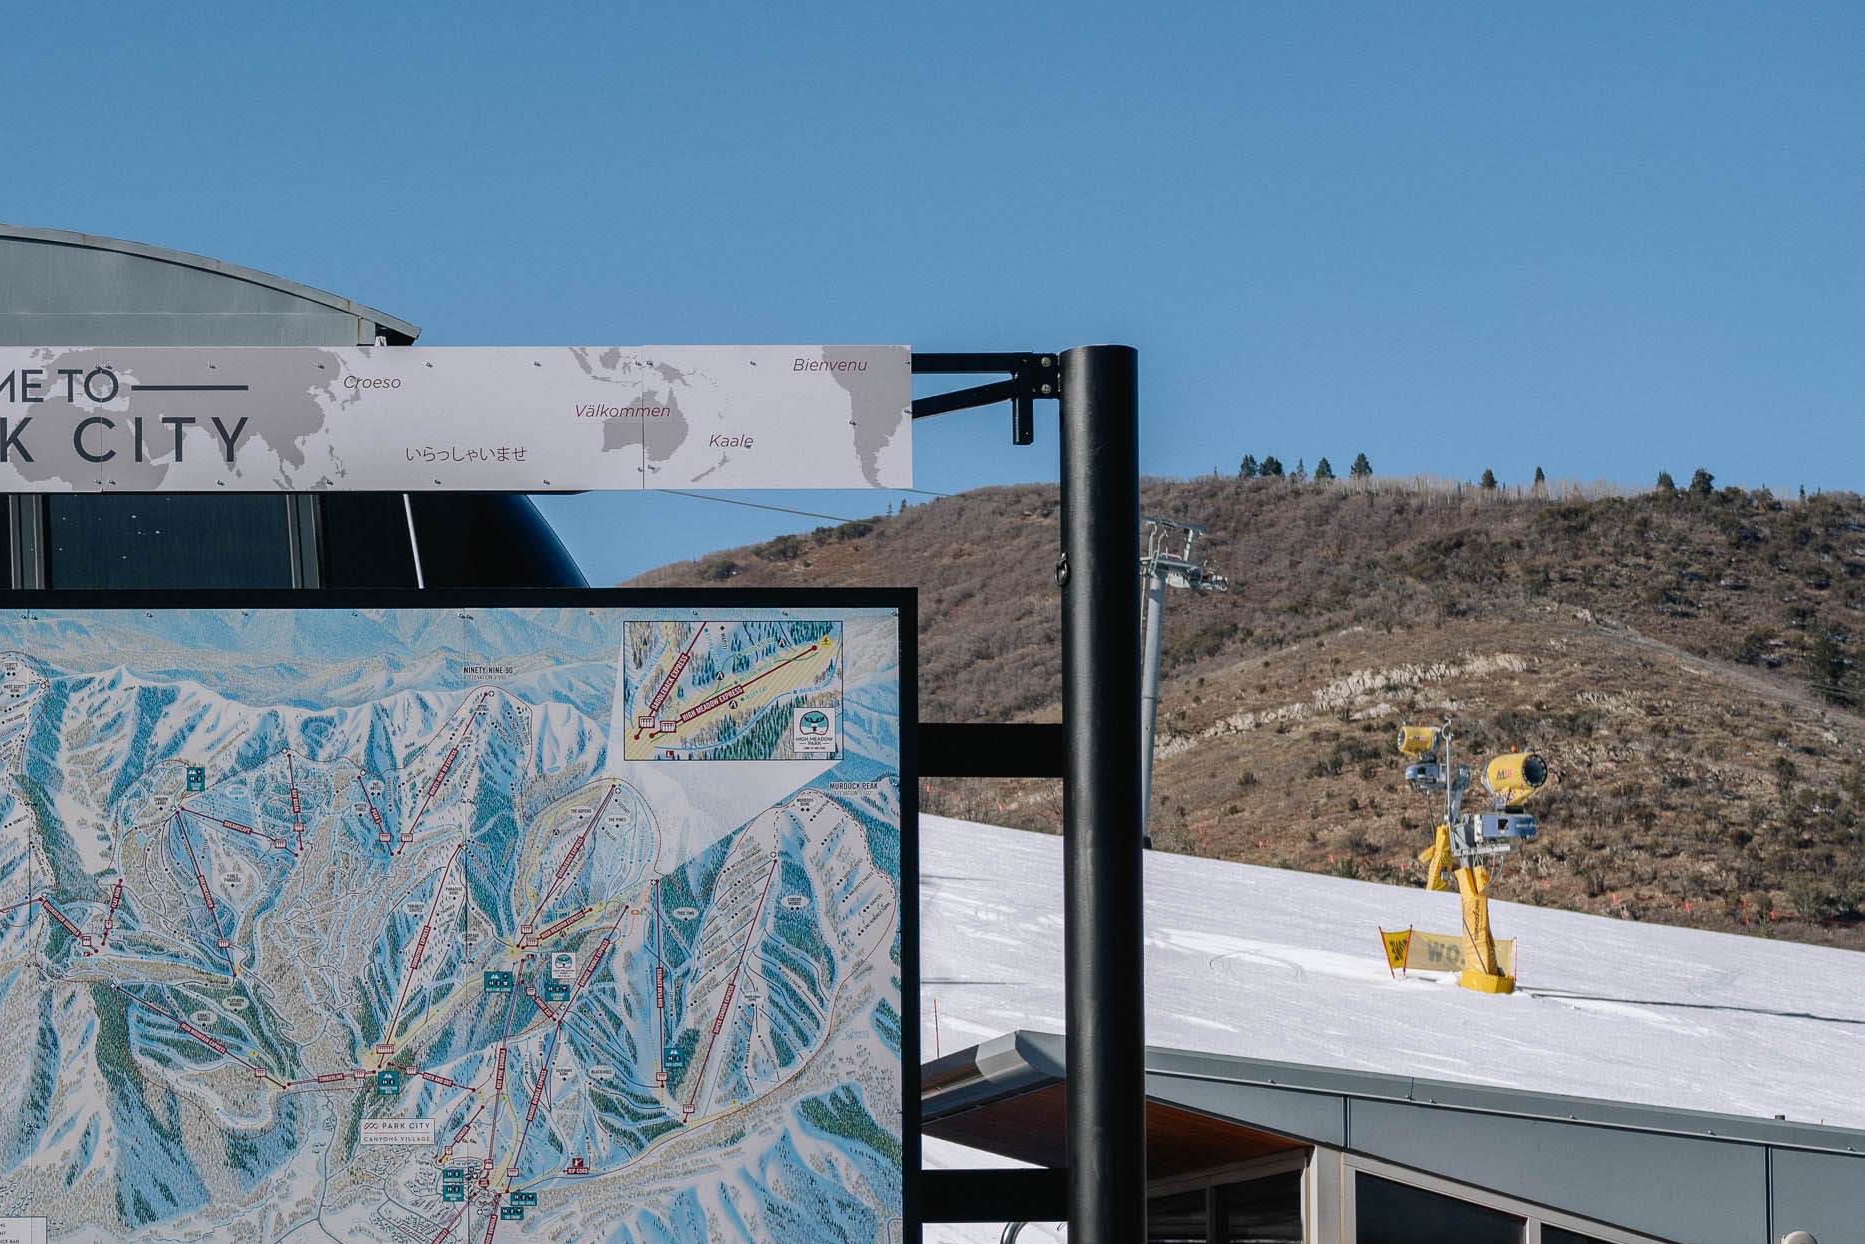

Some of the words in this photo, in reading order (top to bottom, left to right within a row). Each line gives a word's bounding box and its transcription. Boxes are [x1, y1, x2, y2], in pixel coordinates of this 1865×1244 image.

[792, 358, 868, 372] Bienvenu
[57, 369, 119, 404] TO
[343, 375, 401, 389] Croeso
[575, 404, 671, 418] Välkommen
[73, 417, 249, 463] CITY
[405, 446, 527, 463] いらっしゃいませ
[651, 678, 674, 711] SADDLEBACK
[670, 654, 689, 680] EXPRESS
[683, 710, 697, 722] HIGH
[698, 699, 718, 716] MEADOW
[718, 686, 743, 706] EXPRESS
